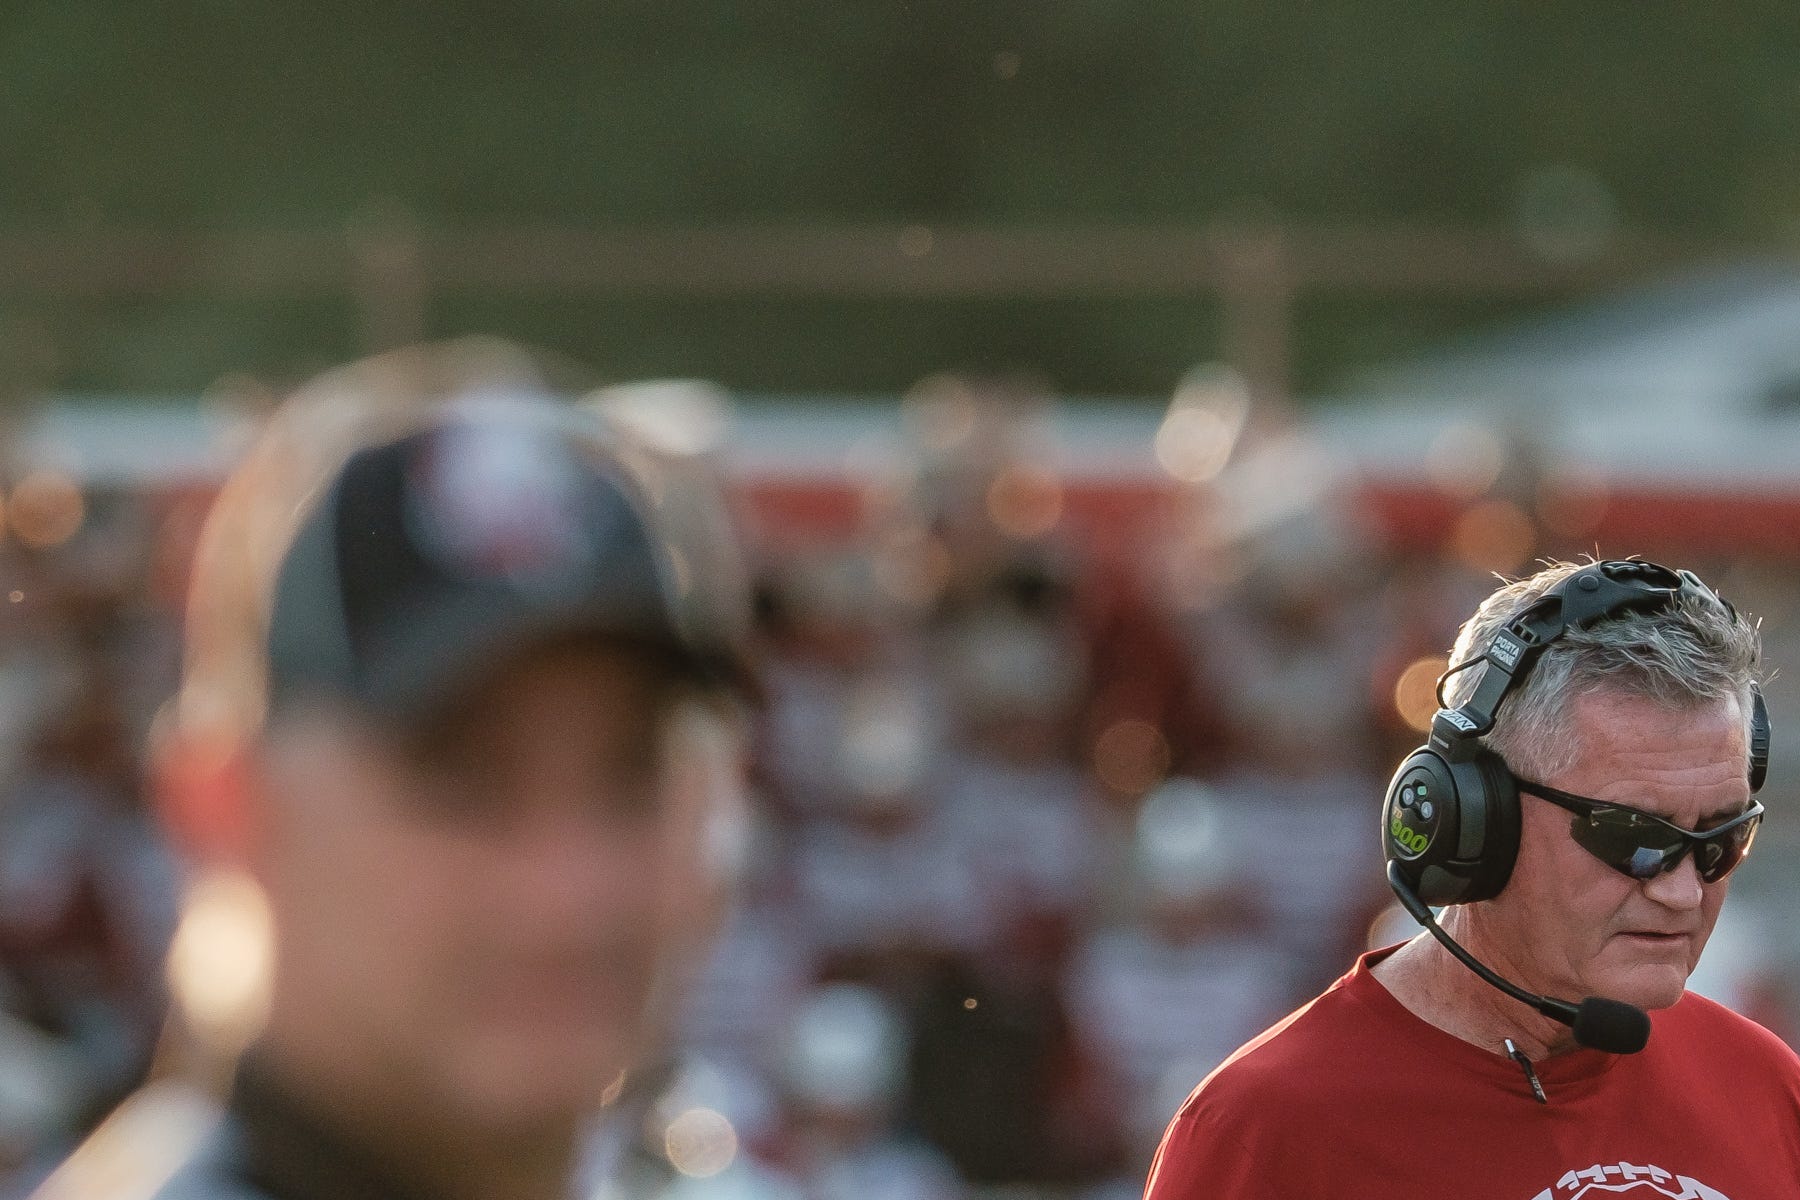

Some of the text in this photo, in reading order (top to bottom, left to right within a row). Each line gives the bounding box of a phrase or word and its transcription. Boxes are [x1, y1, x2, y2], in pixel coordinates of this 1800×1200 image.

[1490, 645, 1515, 666] PHONE
[1494, 635, 1520, 657] PORTA
[1391, 819, 1428, 852] 900
